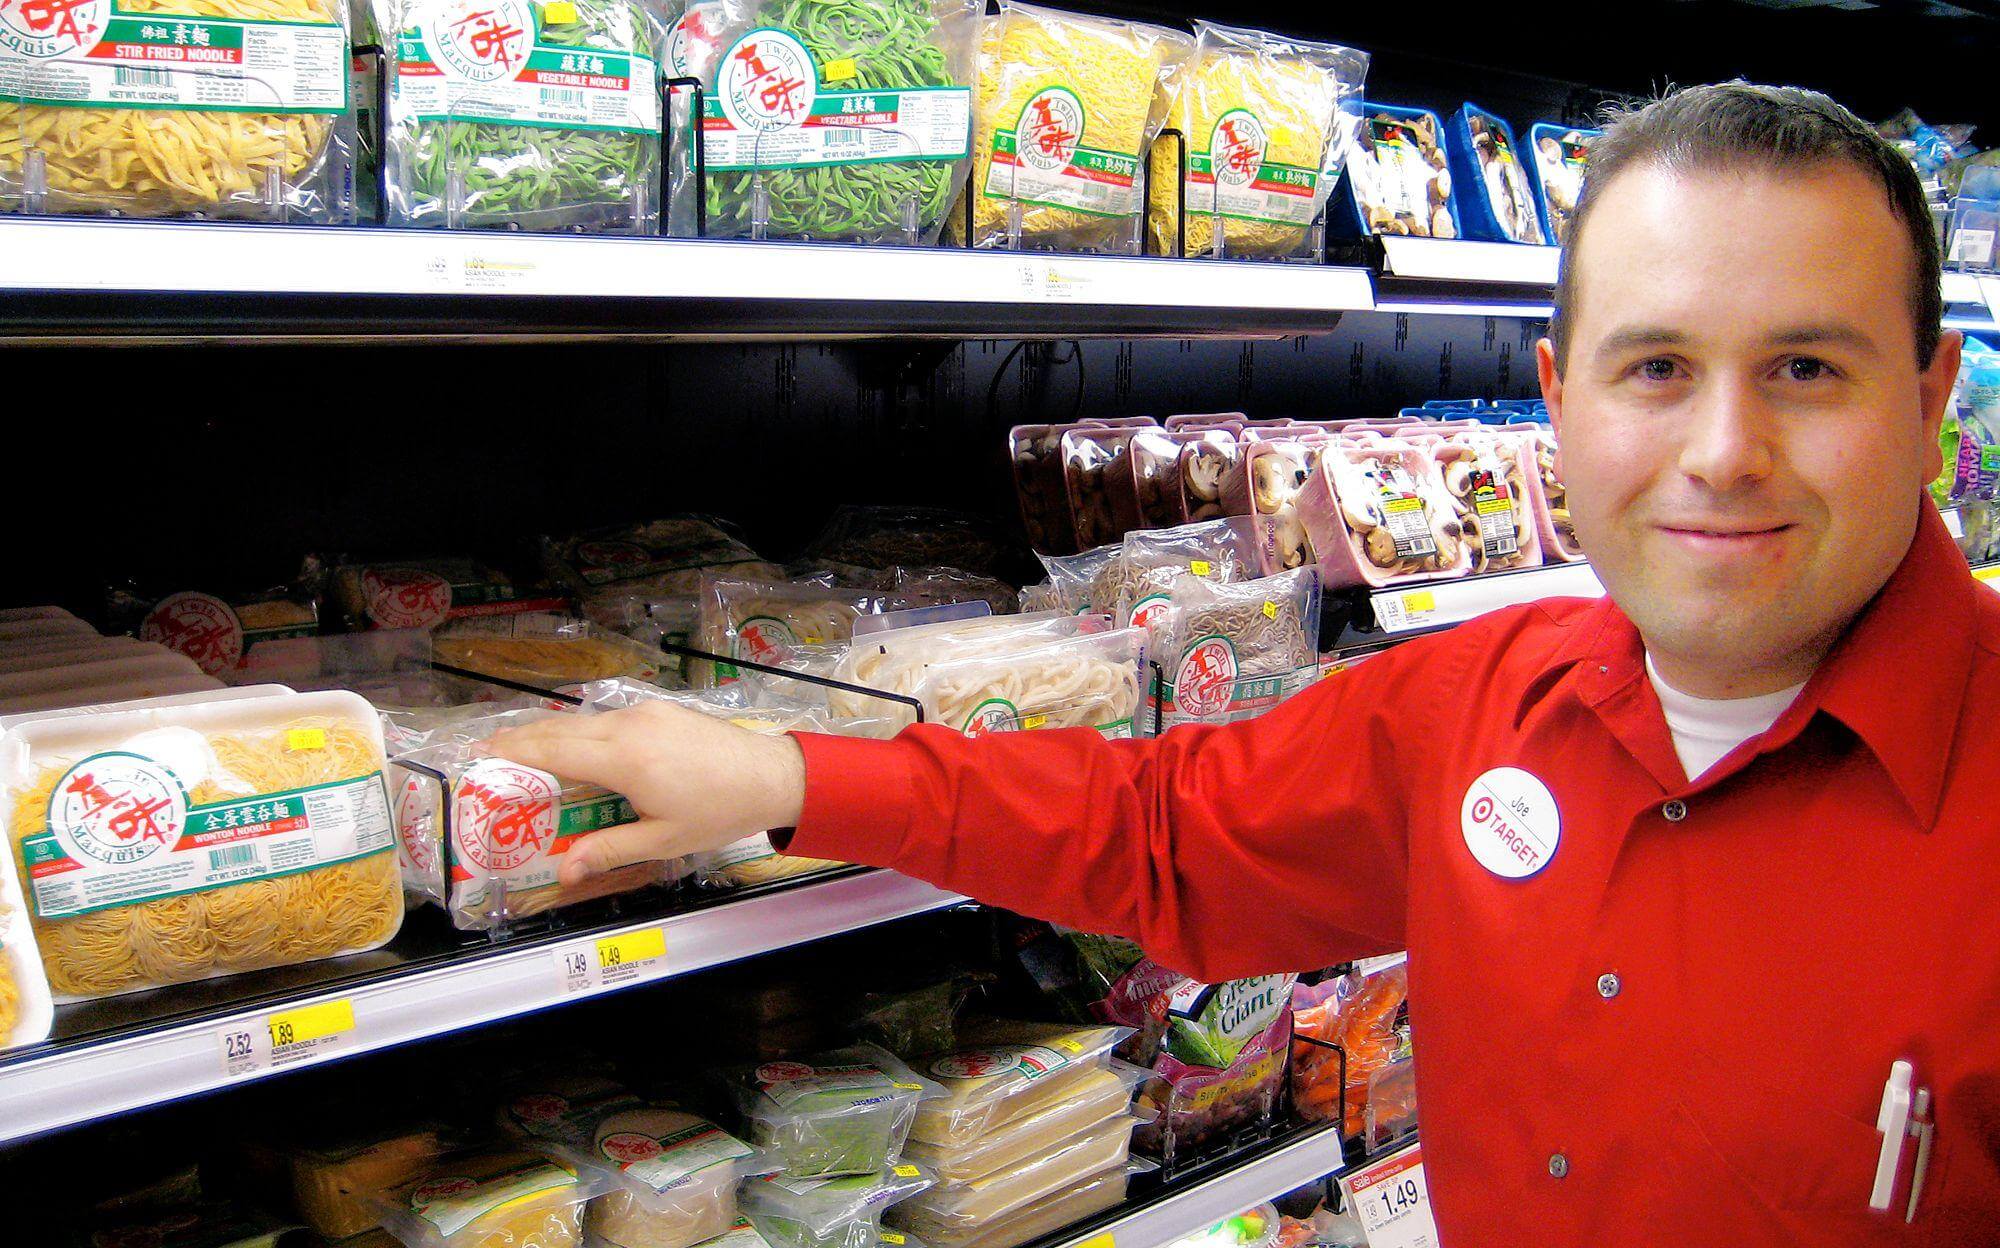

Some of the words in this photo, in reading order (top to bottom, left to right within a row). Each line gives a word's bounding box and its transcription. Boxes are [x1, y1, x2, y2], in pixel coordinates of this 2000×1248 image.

[115, 45, 144, 58] STIR
[147, 47, 184, 60] FRIED
[187, 49, 235, 62] NOODLE
[536, 72, 588, 86] VEGETABLE
[589, 76, 624, 89] NOODLE
[820, 114, 863, 125] VEGETABLE
[864, 113, 892, 124] NOODLE
[1210, 646, 1228, 667] Twin
[205, 801, 290, 831] 全蛋雲吞麵
[1511, 795, 1530, 817] Joe
[193, 830, 235, 844] WONTON
[237, 823, 272, 837] NOODLE
[1489, 814, 1539, 867] TARGET
[71, 825, 147, 864] Marquis
[206, 874, 218, 882] NET
[566, 953, 587, 974] 1.49
[600, 946, 621, 968] 1.49
[602, 965, 618, 975] ASIAN
[618, 961, 640, 971] NOODLE
[1222, 986, 1274, 1034] Giant
[225, 1032, 253, 1058] 2.52
[269, 1023, 295, 1048] 1.89
[271, 1045, 290, 1055] ASIAN
[291, 1038, 318, 1051] NOODLE
[1353, 1174, 1371, 1190] sale
[1381, 1179, 1418, 1216] 1.49
